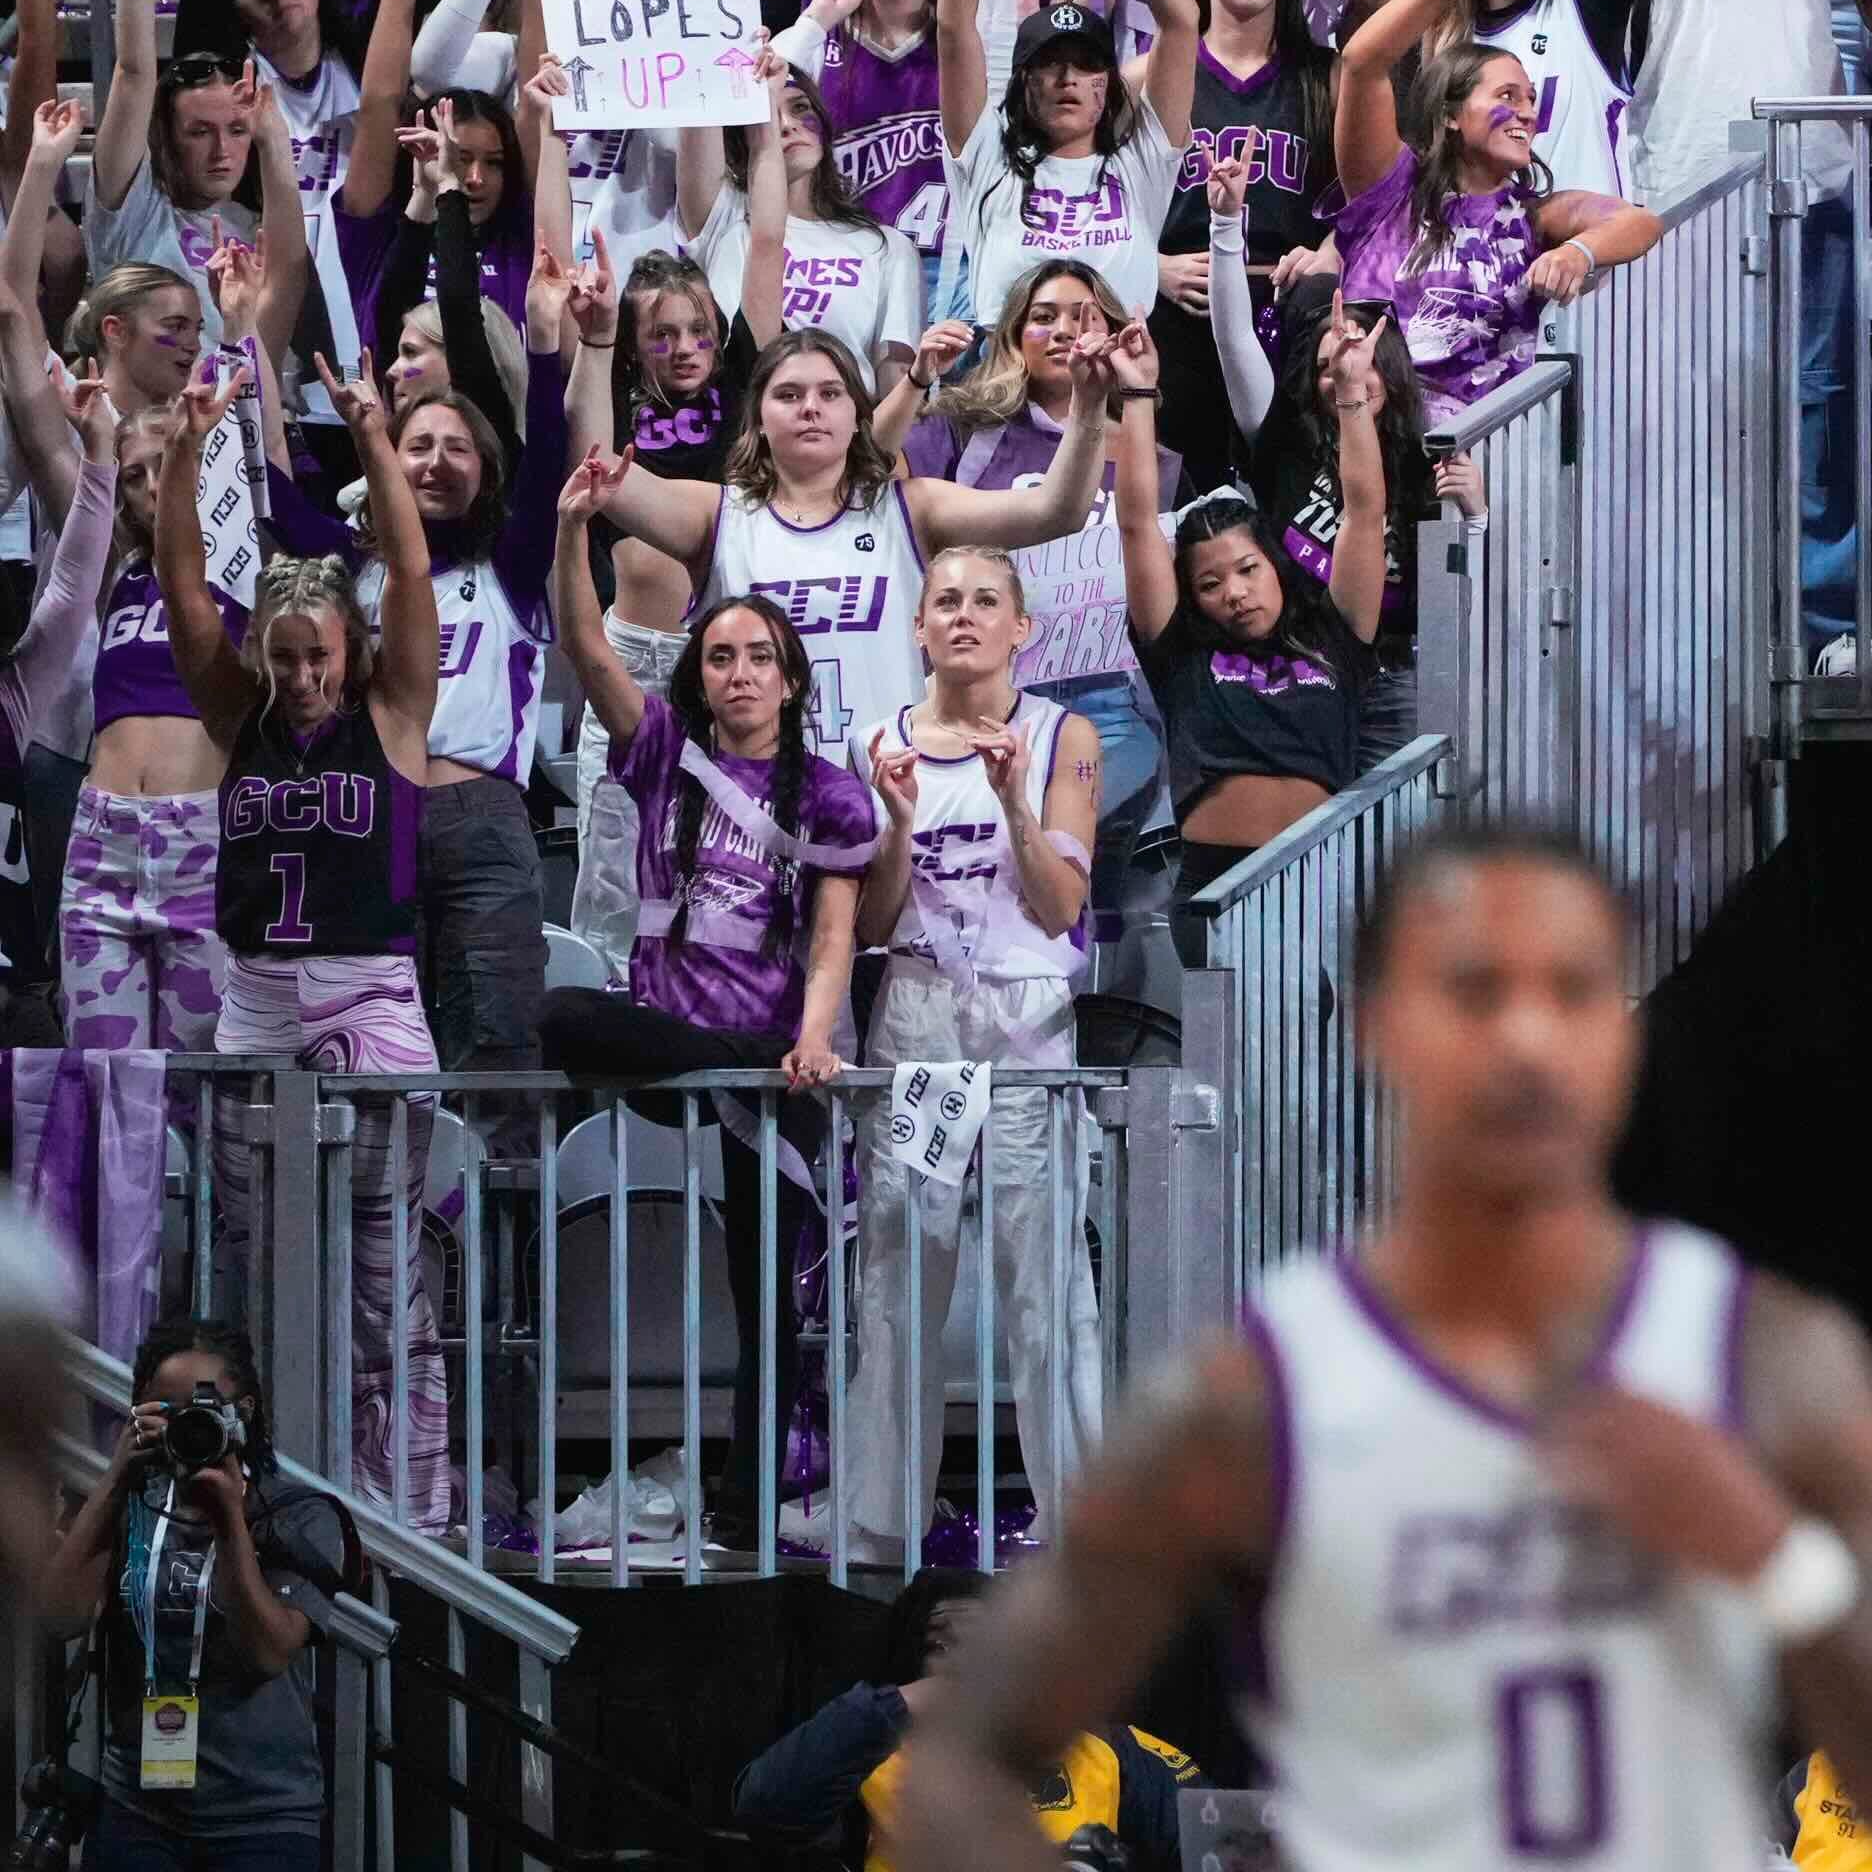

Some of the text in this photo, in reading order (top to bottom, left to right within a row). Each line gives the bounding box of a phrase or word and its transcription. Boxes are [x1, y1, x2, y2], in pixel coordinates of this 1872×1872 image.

[620, 53, 681, 110] UP
[895, 184, 948, 246] 4
[203, 427, 229, 469] GCU
[211, 486, 238, 527] GCU
[222, 545, 250, 586] GCU
[1055, 576, 1107, 605] TO THE
[227, 774, 373, 840] GCU
[265, 852, 313, 942] 1
[903, 1066, 930, 1114] GCU
[925, 1126, 948, 1169] GCU
[1497, 1663, 1606, 1856] 0
